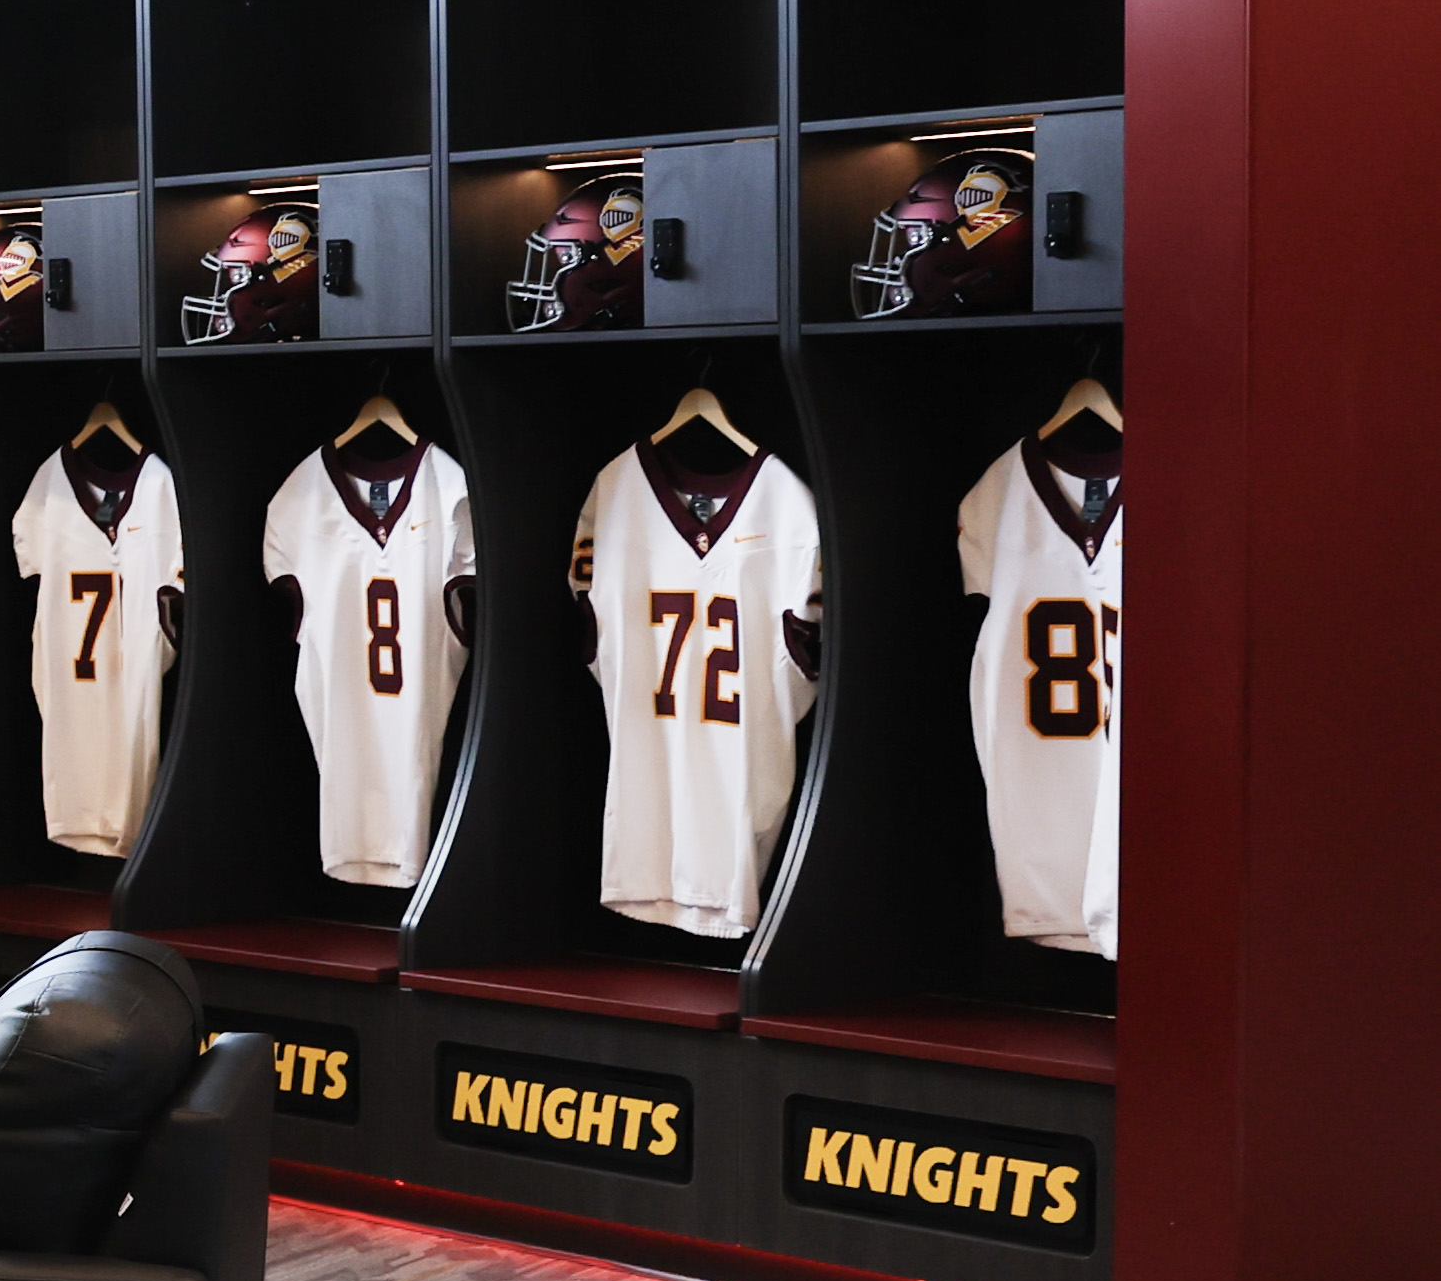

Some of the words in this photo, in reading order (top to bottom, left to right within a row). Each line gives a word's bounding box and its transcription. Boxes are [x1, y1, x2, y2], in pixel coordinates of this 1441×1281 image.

[367, 576, 404, 697] 8
[649, 588, 741, 727] 72
[452, 1070, 680, 1157] KNIGHTS
[804, 1126, 1080, 1225] KNIGHTS
